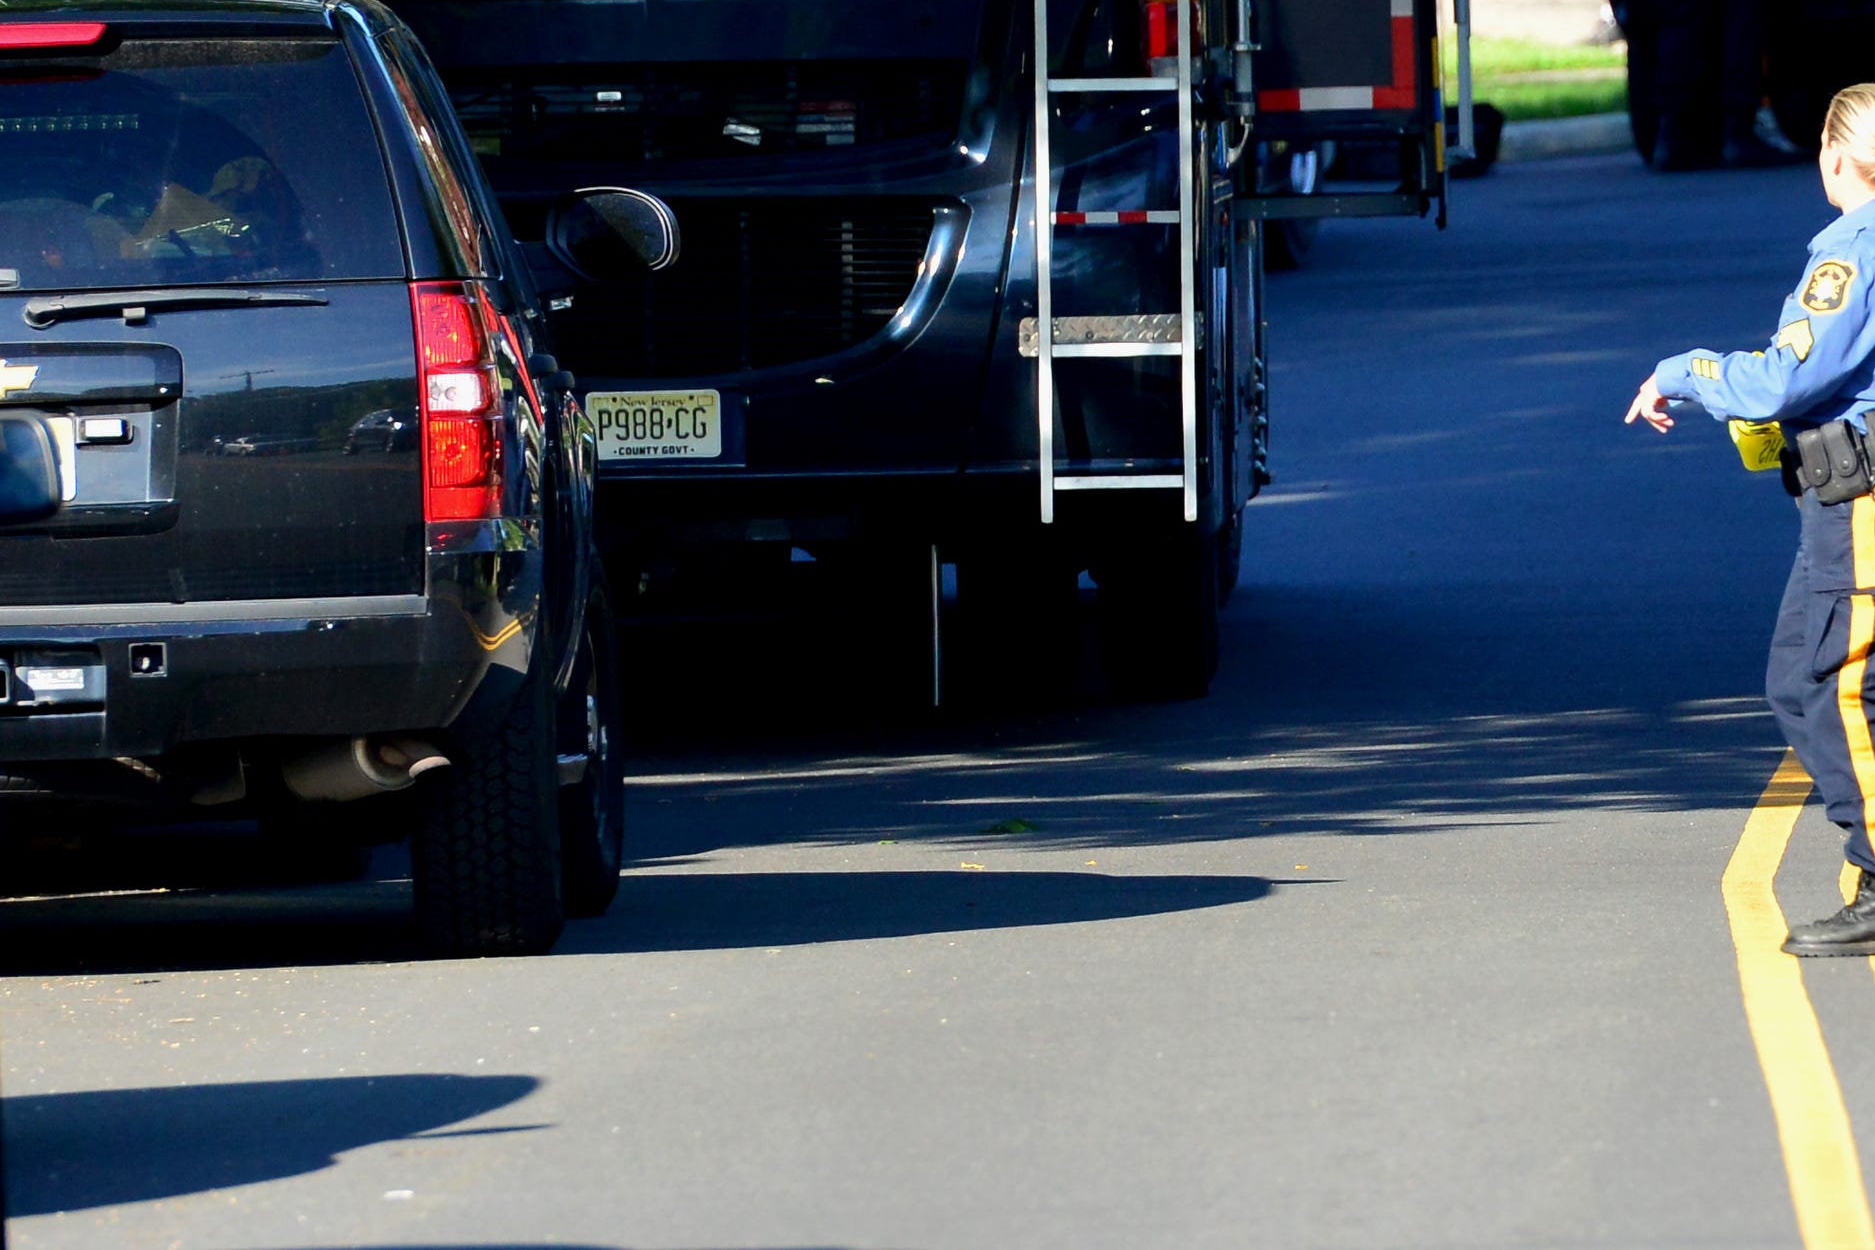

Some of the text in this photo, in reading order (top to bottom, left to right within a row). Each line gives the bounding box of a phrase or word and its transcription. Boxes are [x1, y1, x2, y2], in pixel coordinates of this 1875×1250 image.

[620, 395, 685, 407] New Jersey
[618, 445, 689, 456] COUNTY GOVT
